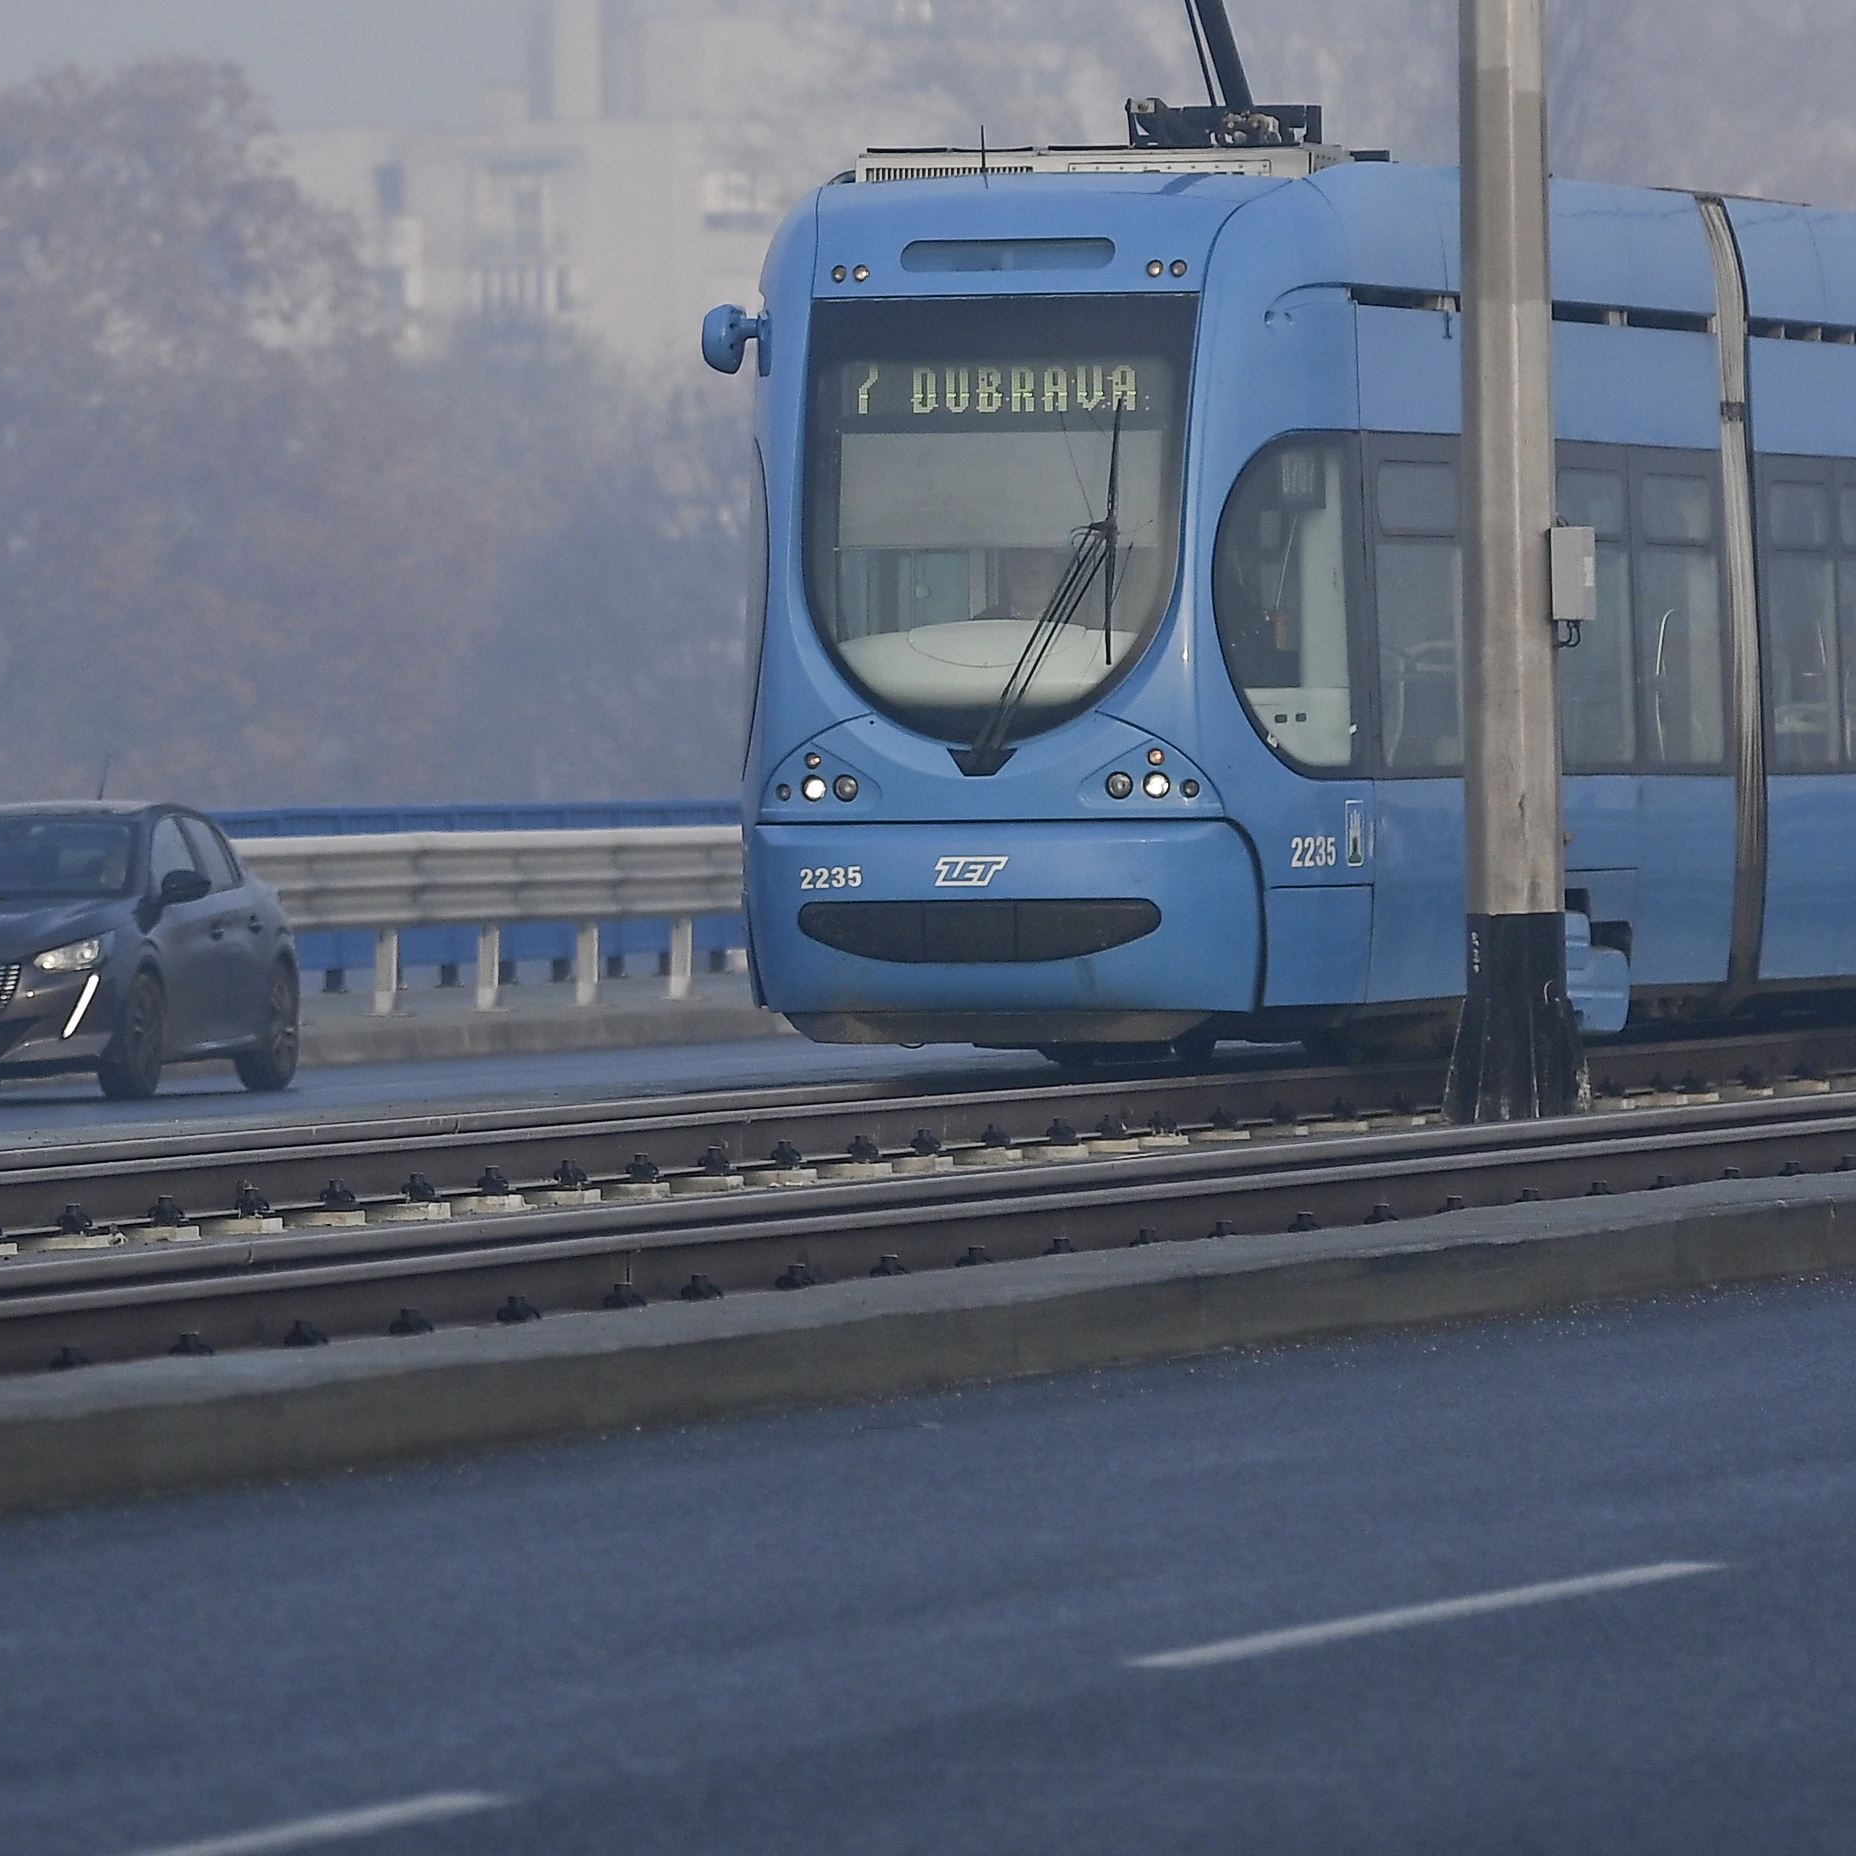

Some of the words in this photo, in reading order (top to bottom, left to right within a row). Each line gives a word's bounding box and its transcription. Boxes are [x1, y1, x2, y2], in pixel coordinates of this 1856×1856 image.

[857, 364, 879, 414] 7
[911, 365, 1137, 413] DUBRAVA
[1291, 836, 1337, 867] 2235
[800, 866, 862, 890] 2235
[934, 856, 1009, 887] ZET
